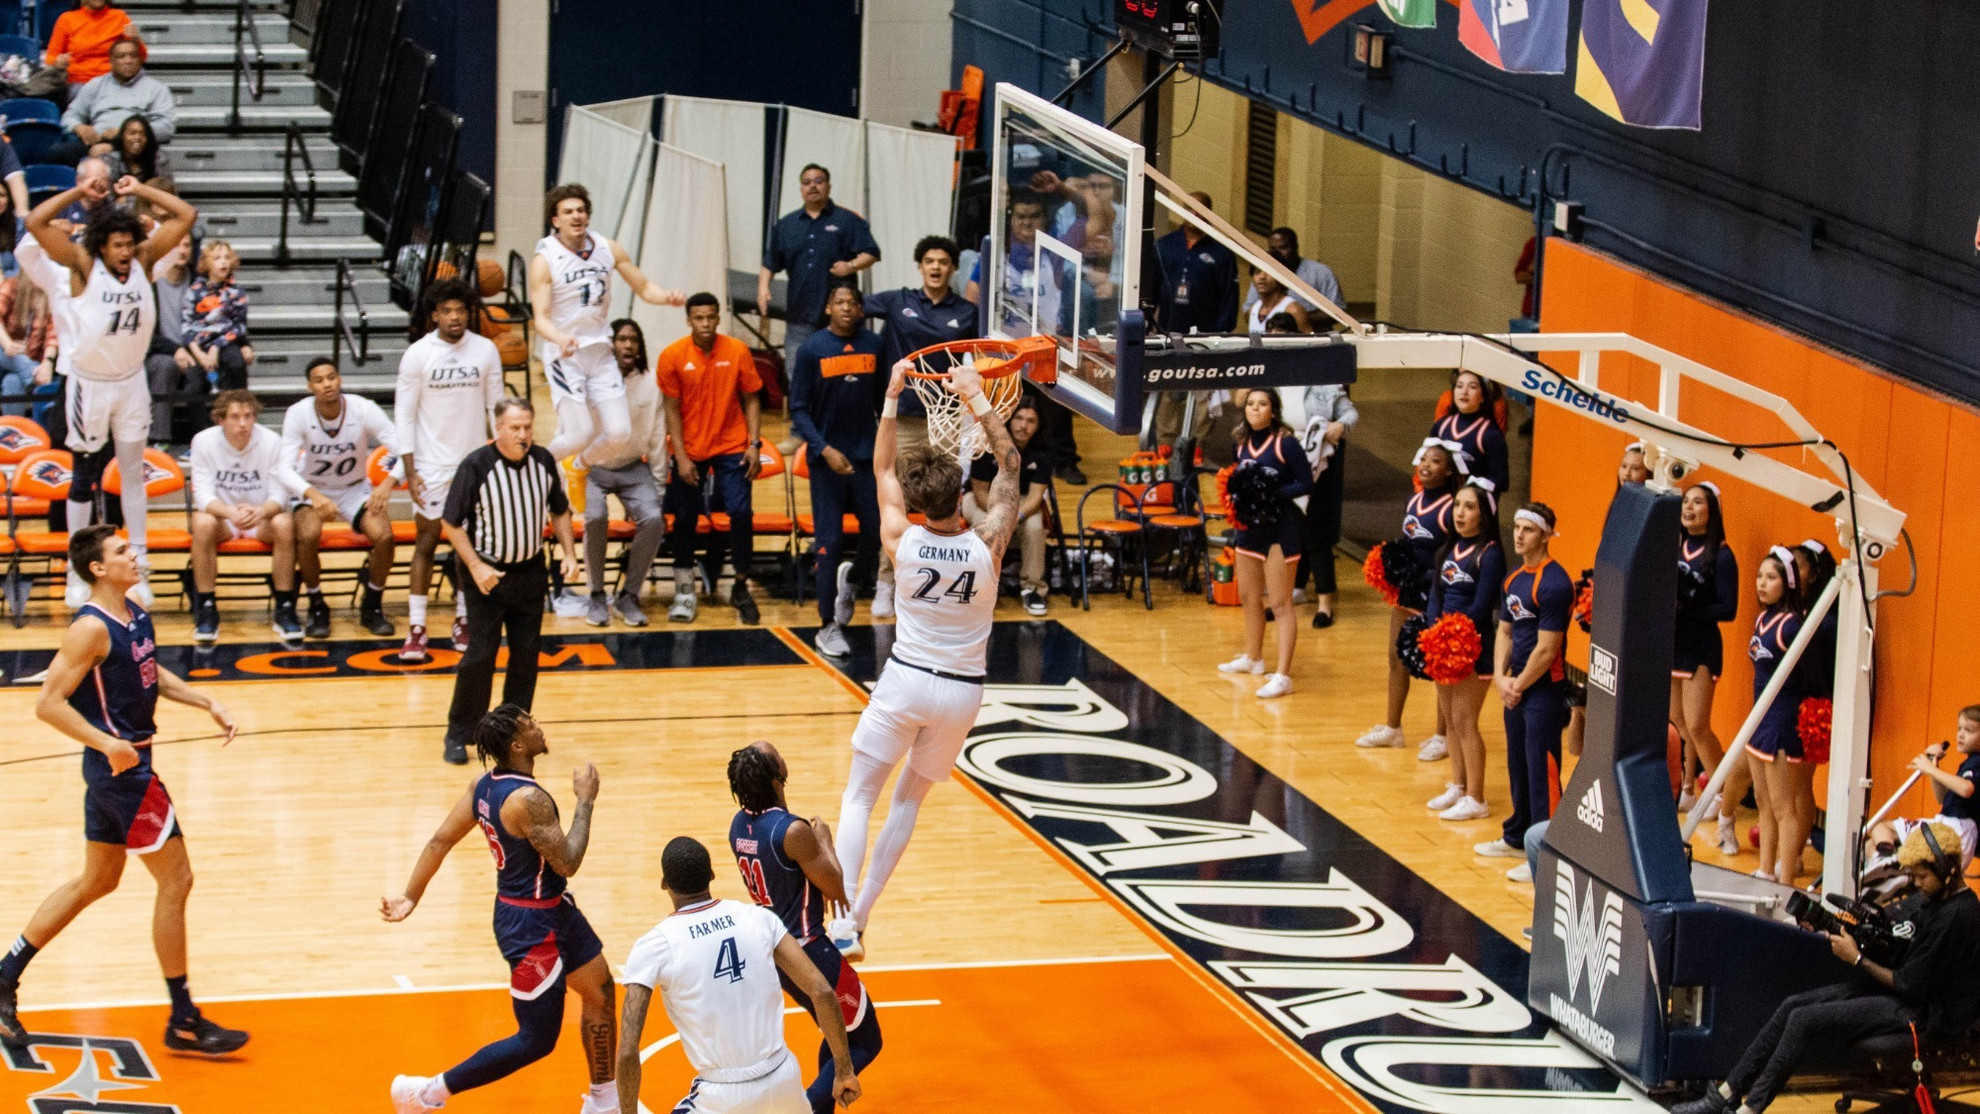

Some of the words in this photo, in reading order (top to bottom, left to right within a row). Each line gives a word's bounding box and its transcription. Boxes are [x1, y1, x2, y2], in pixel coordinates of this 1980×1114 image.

[103, 290, 142, 304] UTSA
[579, 279, 606, 306] 12
[105, 307, 141, 335] 14
[431, 366, 480, 381] UTSA
[310, 442, 356, 454] UTSA
[215, 469, 260, 483] UTSA
[310, 457, 357, 476] 20
[918, 545, 971, 563] GERMANY
[911, 567, 978, 604] 24
[1594, 649, 1612, 672] BUD
[1591, 662, 1616, 690] LIGHT
[689, 915, 735, 939] FARMER
[714, 936, 746, 984] 4
[1550, 992, 1615, 1060] WHATABURGER
